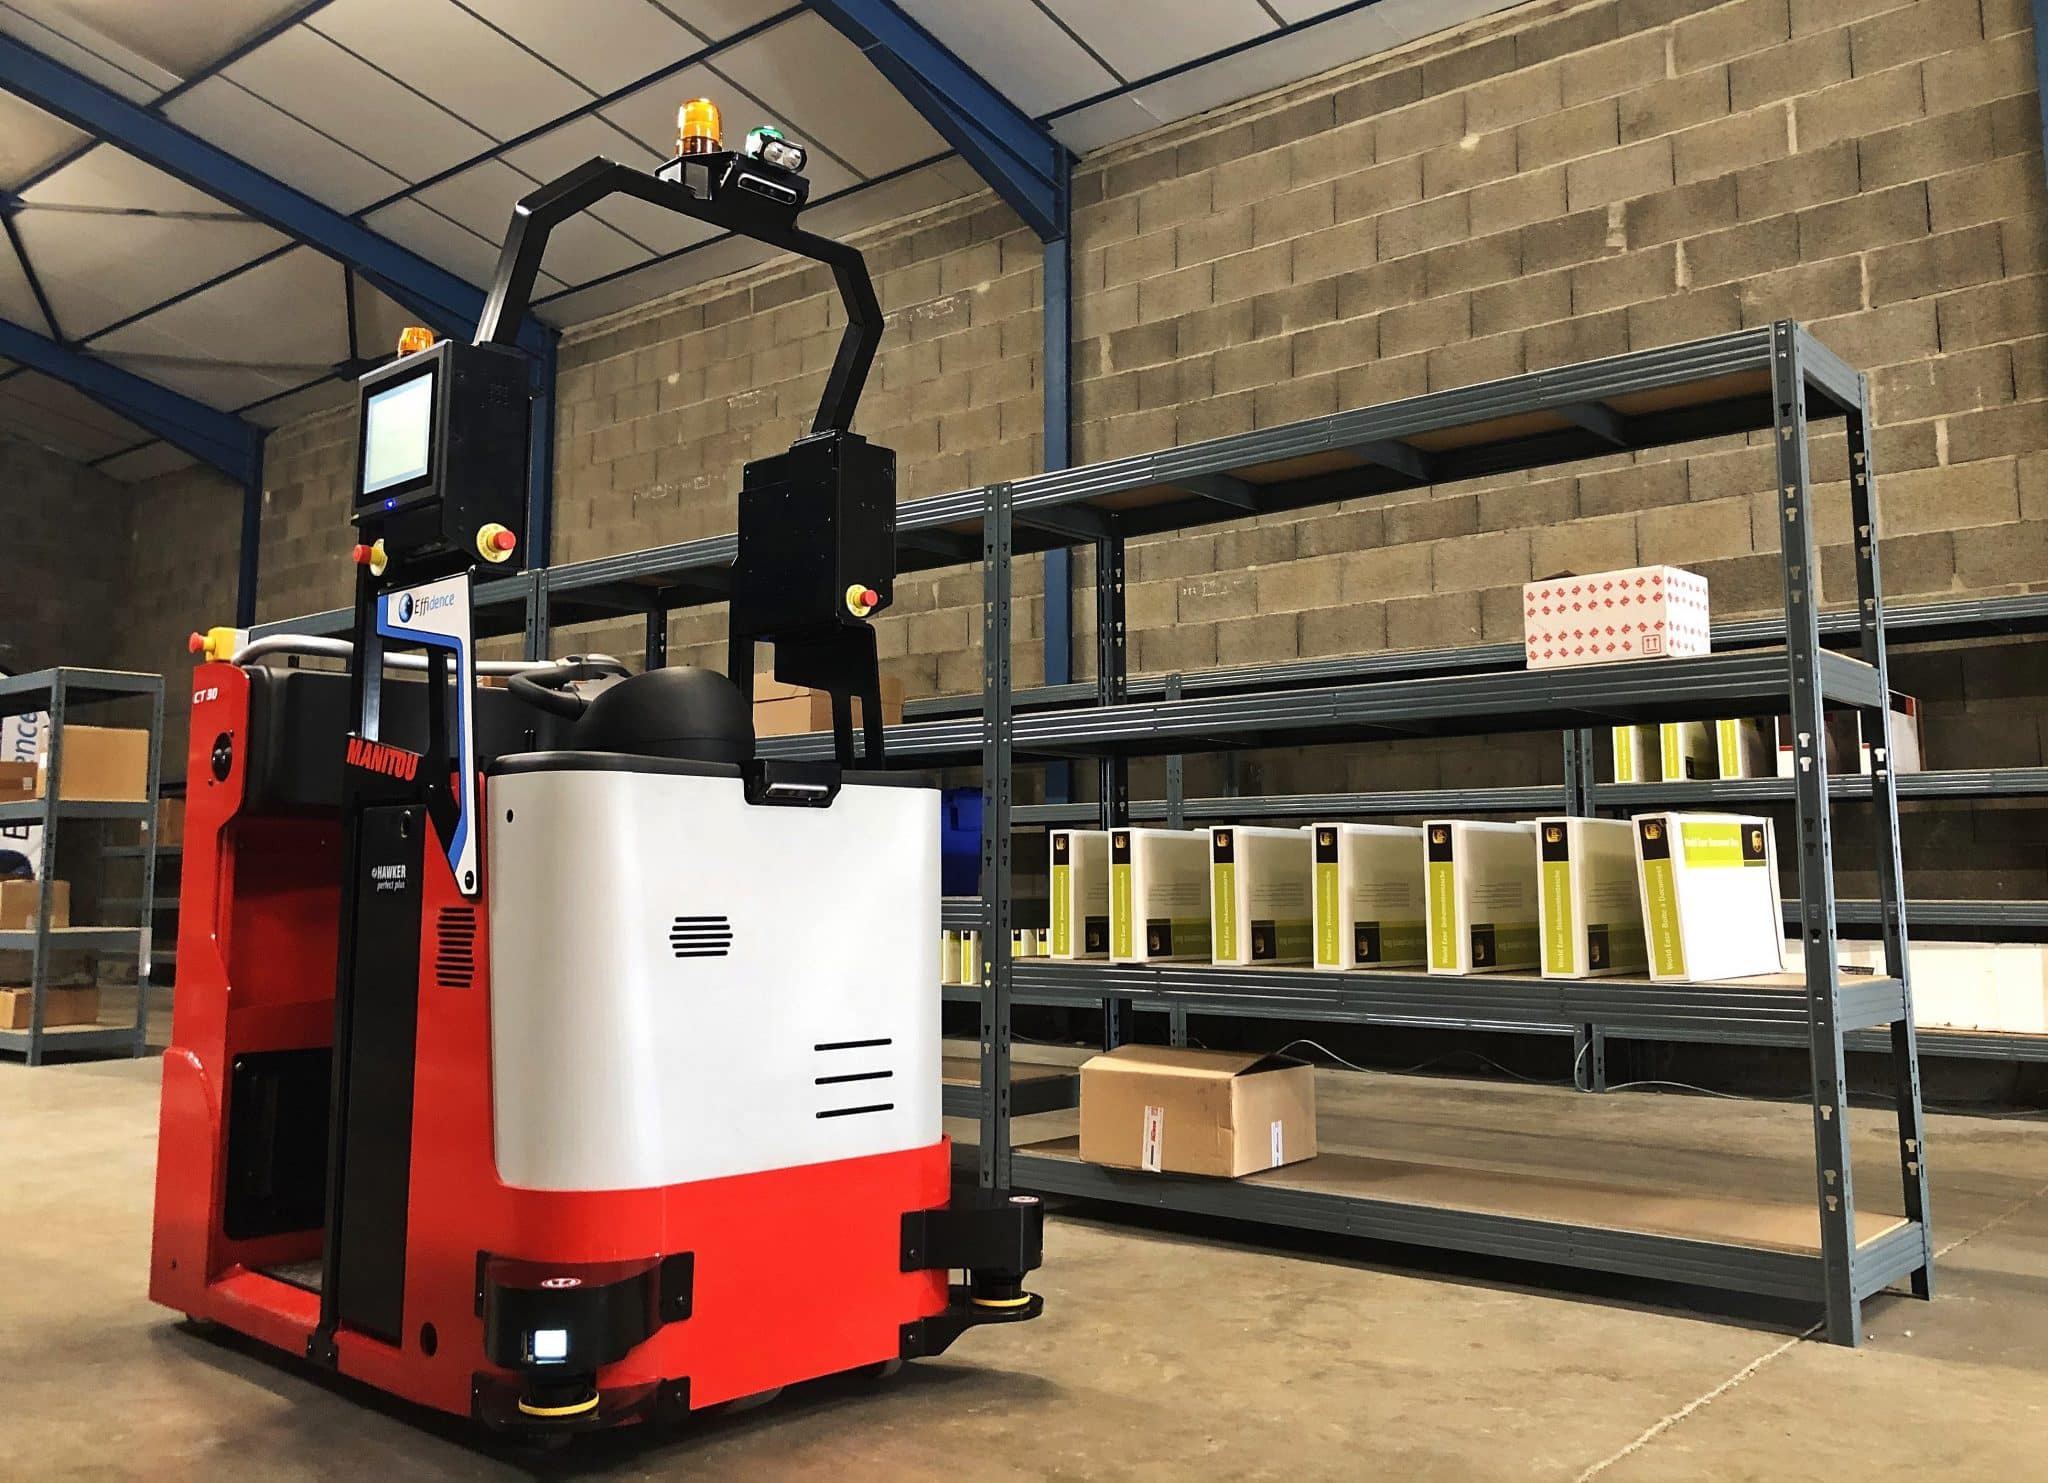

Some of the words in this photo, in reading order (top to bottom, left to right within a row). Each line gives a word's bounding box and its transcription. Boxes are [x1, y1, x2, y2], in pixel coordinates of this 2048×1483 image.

[414, 593, 454, 616] Effidence
[194, 690, 206, 704] CT
[206, 687, 218, 701] 30
[346, 738, 418, 782] MANITOU
[378, 864, 406, 879] HAWKER
